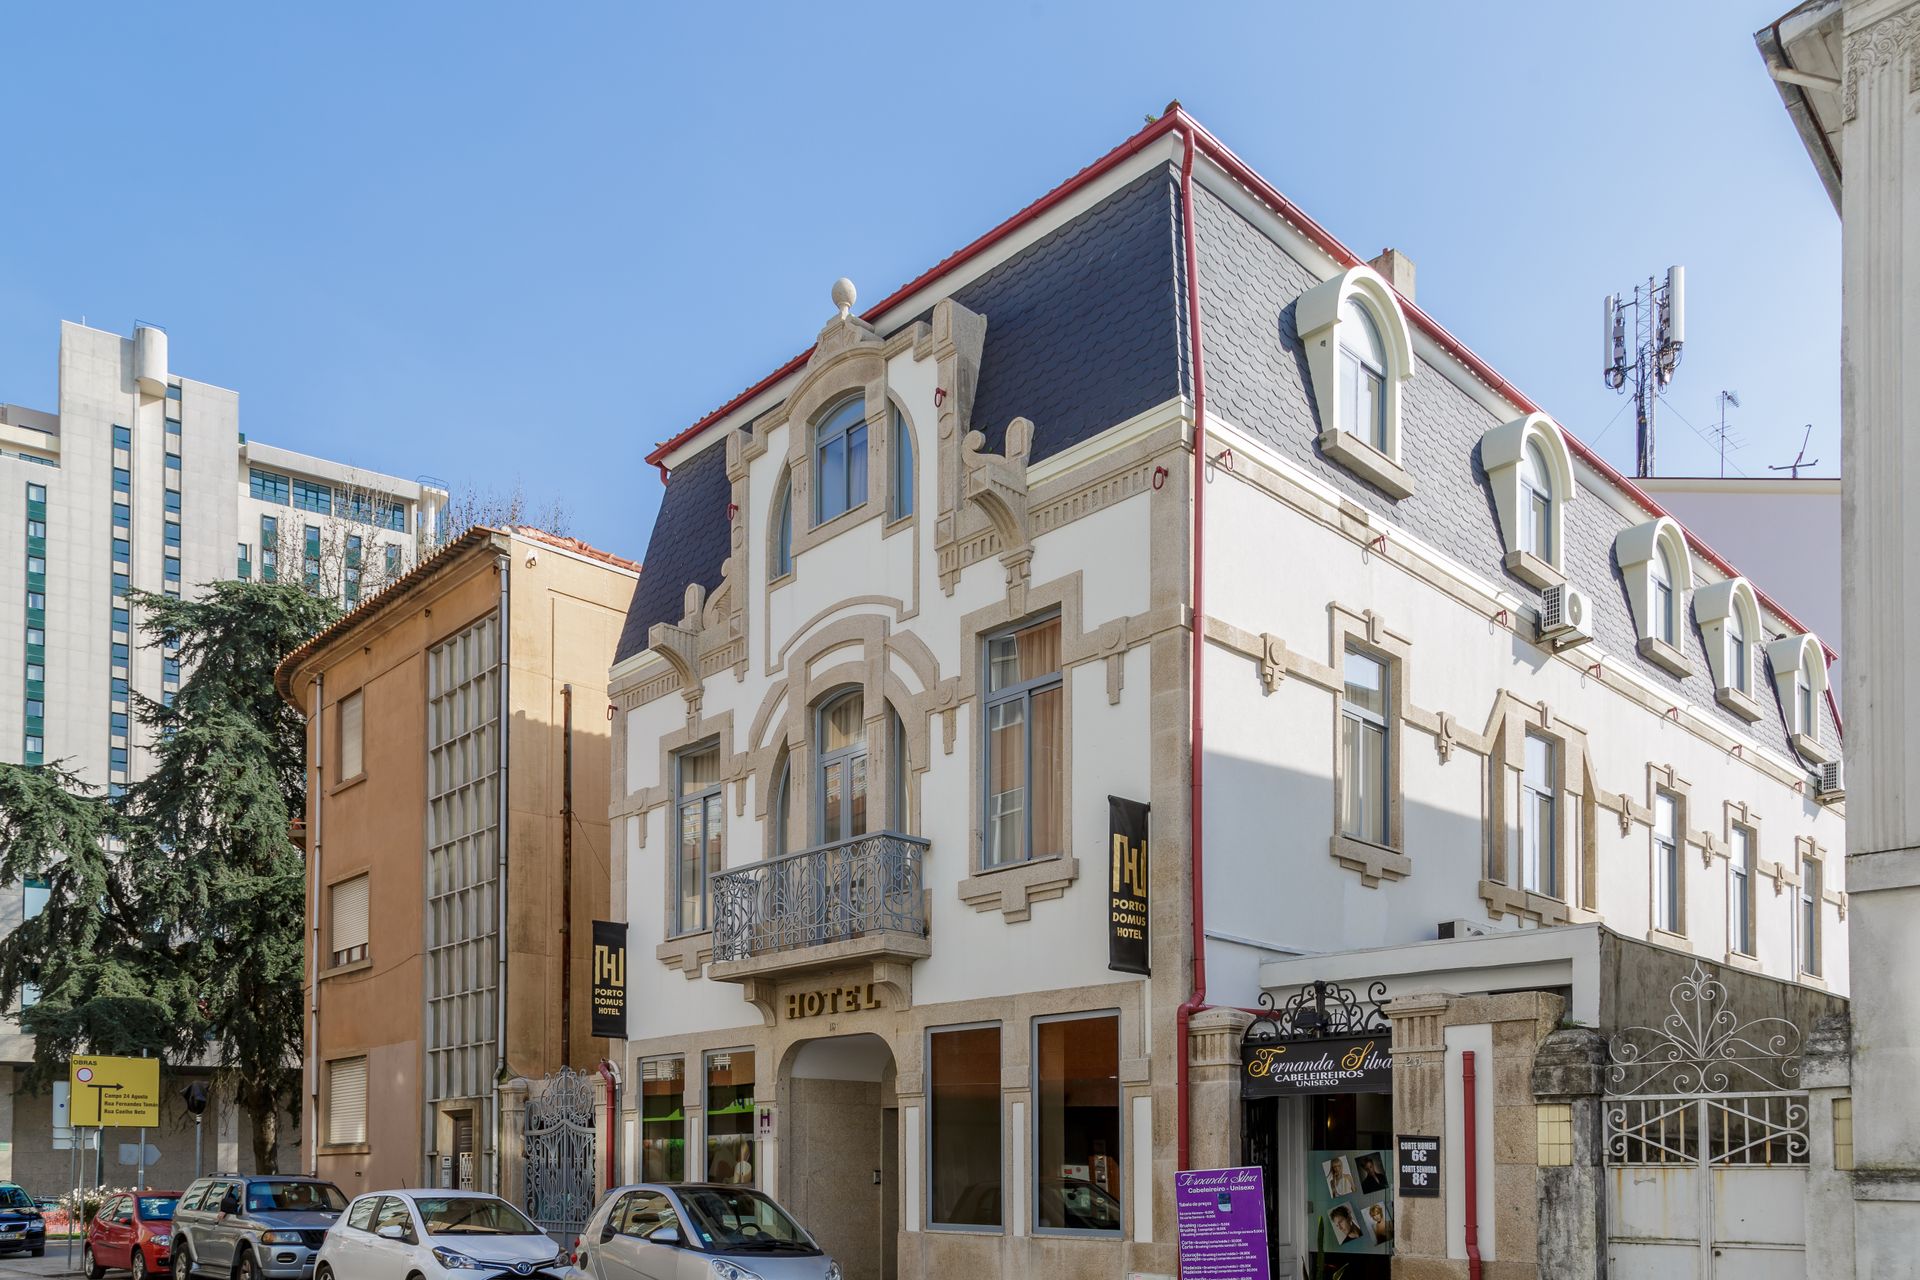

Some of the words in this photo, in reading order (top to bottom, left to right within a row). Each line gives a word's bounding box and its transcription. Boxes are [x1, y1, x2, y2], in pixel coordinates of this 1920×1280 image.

[1113, 898, 1146, 913] PORTO
[1113, 912, 1146, 926] DOMUS
[1117, 927, 1143, 940] HOTEL
[595, 988, 624, 997] PORTO
[595, 998, 624, 1006] DOMUS
[785, 983, 881, 1019] HOTEL
[598, 1007, 620, 1015] HOTEL
[1248, 1045, 1335, 1077] Fernanda
[1341, 1040, 1393, 1070] Silva
[1274, 1069, 1364, 1083] CABELEIREIROS
[1296, 1079, 1339, 1087] UNISEXO
[760, 1109, 770, 1127] H
[1401, 1142, 1417, 1150] CORTE
[1417, 1142, 1437, 1150] HOMEM
[1411, 1150, 1427, 1161] 6€
[1402, 1165, 1416, 1173] CORTE
[1178, 1170, 1229, 1187] Fernanda
[1230, 1170, 1258, 1183] Silva
[1412, 1173, 1428, 1185] 8€
[1188, 1186, 1226, 1194] Cabeleireiro
